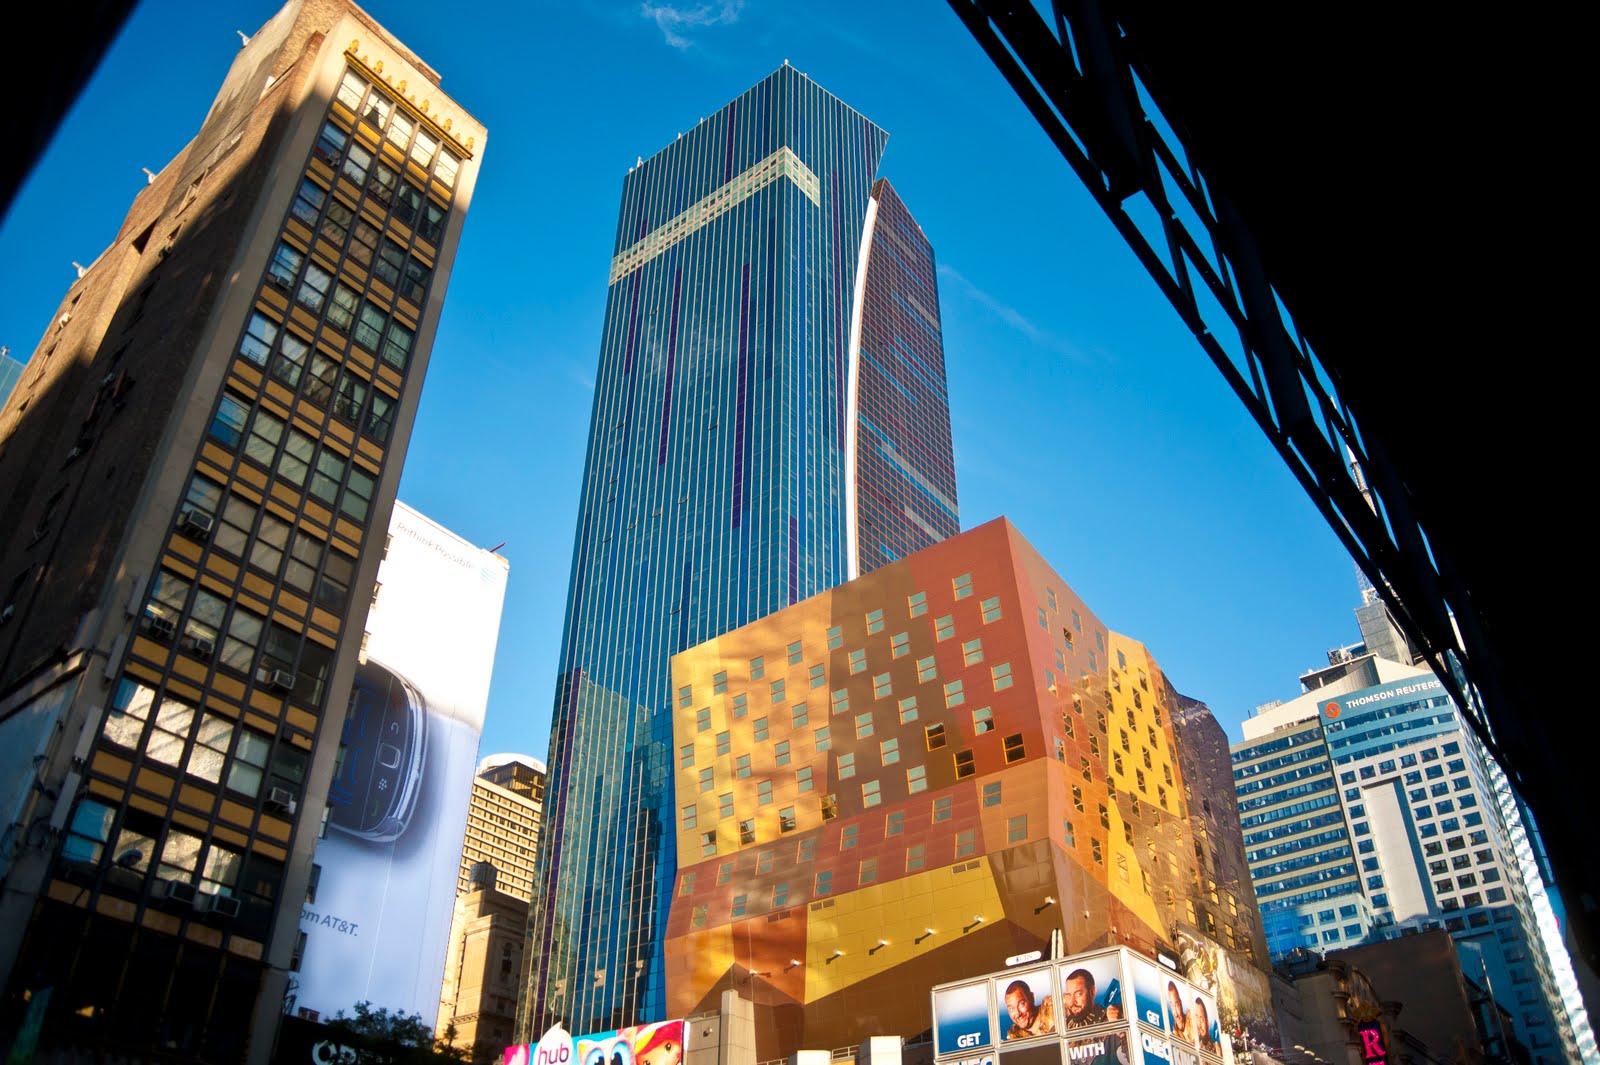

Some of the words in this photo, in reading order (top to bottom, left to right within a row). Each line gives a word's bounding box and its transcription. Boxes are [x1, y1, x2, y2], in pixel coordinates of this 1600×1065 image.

[434, 543, 476, 570] Possibl
[1345, 689, 1395, 709] THOMSON
[1395, 680, 1442, 696] REUTERS
[320, 914, 359, 937] AT&T.
[1146, 1009, 1161, 1027] GET
[957, 1031, 982, 1048] GET
[1068, 1041, 1106, 1061] WITH
[537, 1042, 570, 1065] hub
